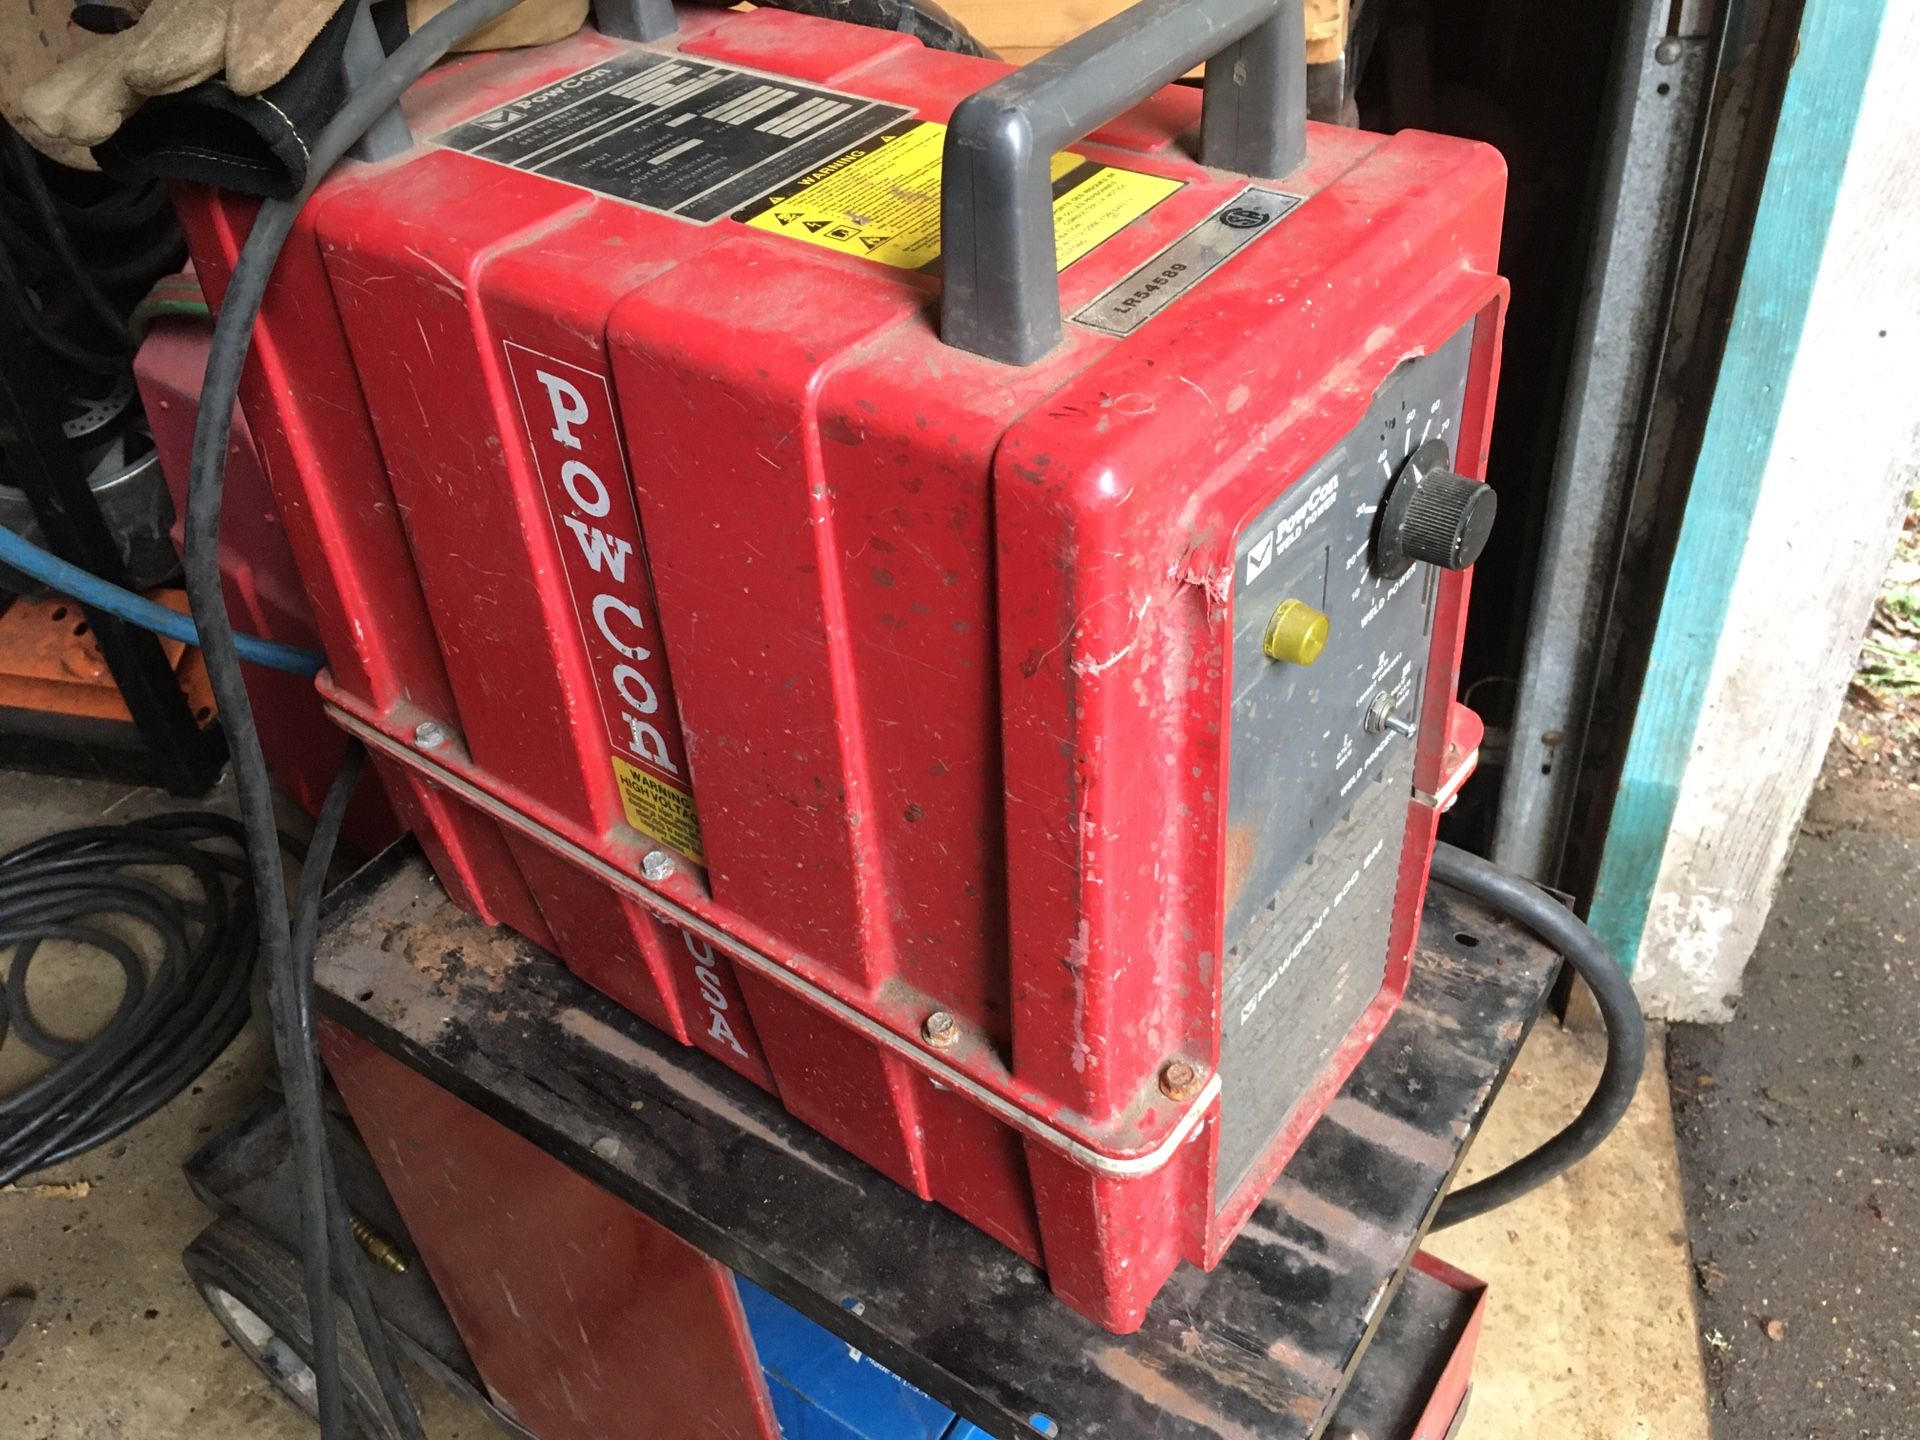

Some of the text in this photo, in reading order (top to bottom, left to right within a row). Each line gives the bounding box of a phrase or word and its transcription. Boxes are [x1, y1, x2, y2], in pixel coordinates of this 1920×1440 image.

[513, 68, 612, 110] PowCon
[535, 109, 580, 130] NUMBER
[556, 108, 601, 129] NUMBER
[633, 114, 672, 133] RATING
[578, 153, 611, 169] INPUT
[629, 162, 673, 185] OUTPUT
[797, 150, 867, 186] WARNING
[1113, 263, 1187, 314] LR54589
[1276, 474, 1338, 544] PowCon
[1276, 491, 1337, 555] WELD POWER
[1361, 562, 1417, 628] WELD POWER
[619, 774, 650, 798] HIGH
[630, 768, 691, 810] WARNING
